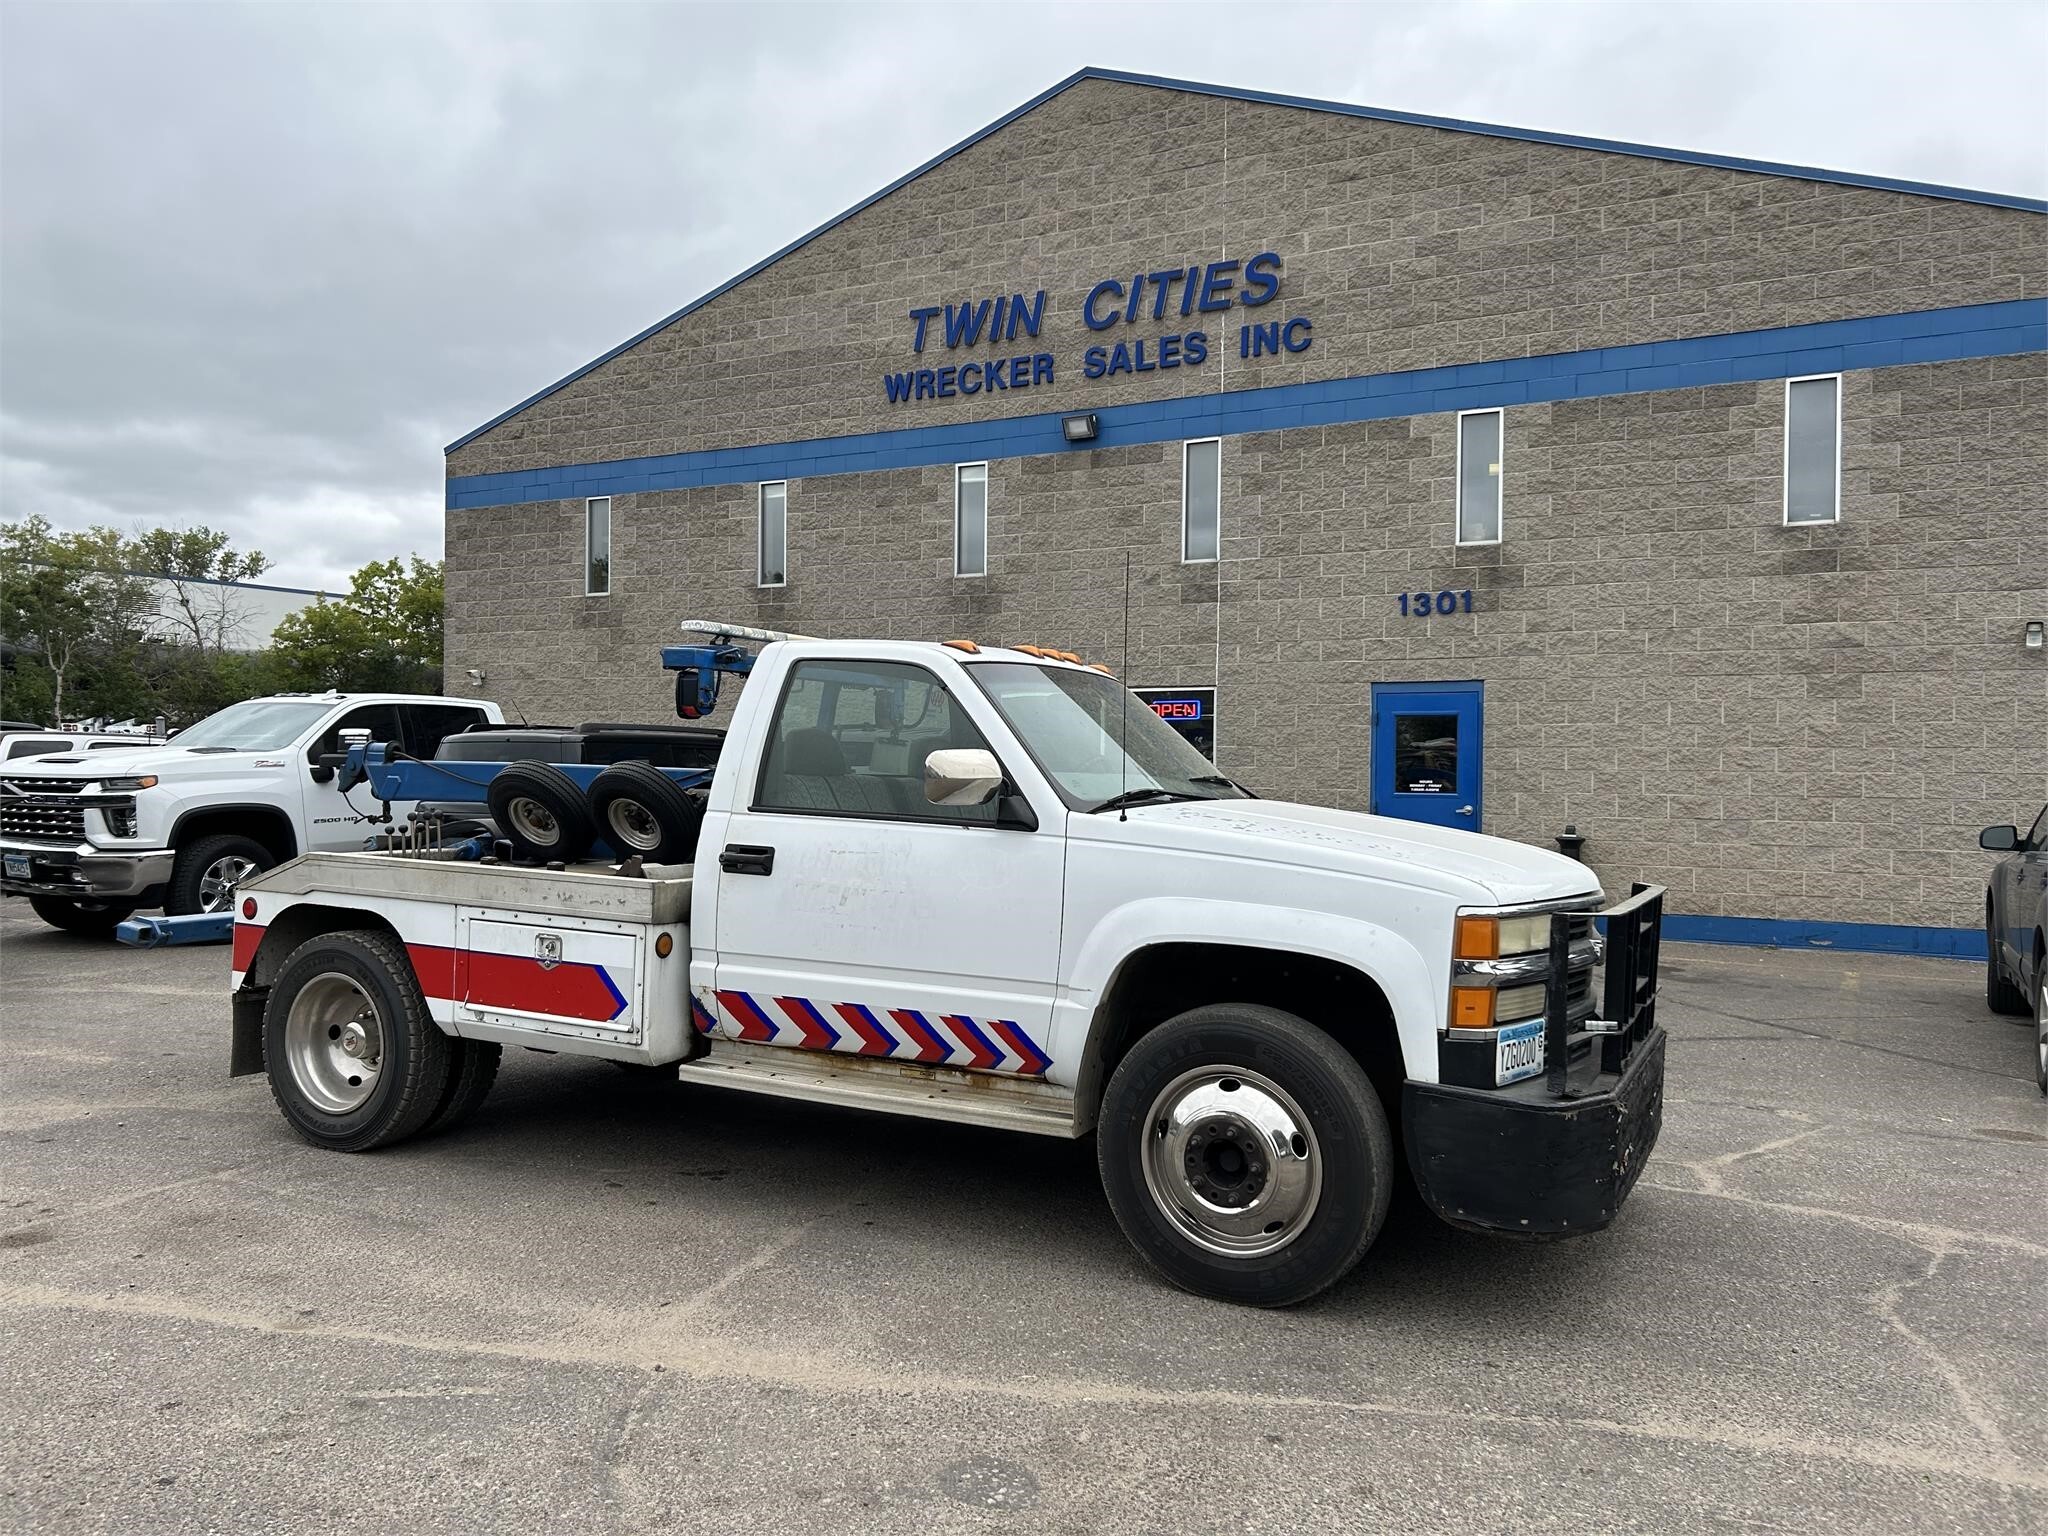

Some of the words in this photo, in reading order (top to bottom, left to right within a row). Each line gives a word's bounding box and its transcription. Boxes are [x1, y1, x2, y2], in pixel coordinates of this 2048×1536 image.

[909, 290, 1046, 352] TWIN
[1083, 252, 1283, 330] CITIES
[884, 353, 1055, 403] WRECKER
[1083, 331, 1208, 378] SALES
[1240, 317, 1313, 358] INC
[1398, 589, 1472, 617] 1301
[1500, 1037, 1537, 1073] YZG0200
